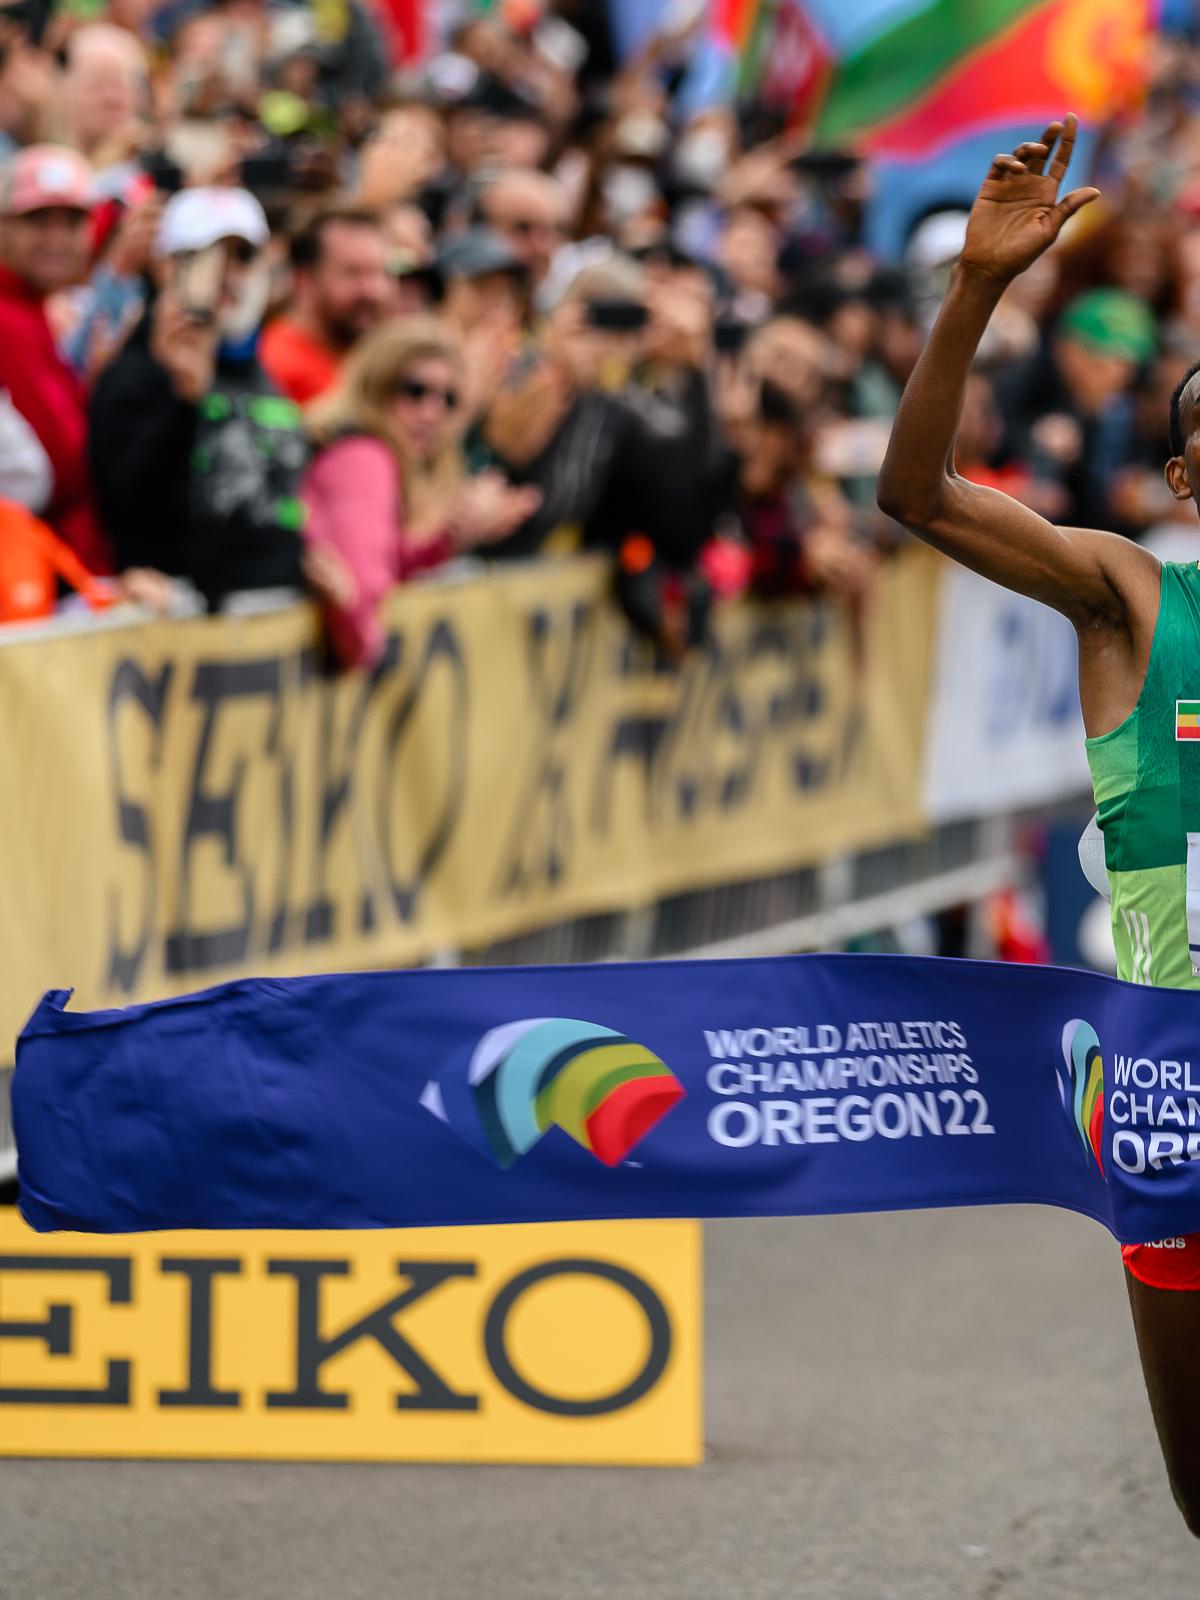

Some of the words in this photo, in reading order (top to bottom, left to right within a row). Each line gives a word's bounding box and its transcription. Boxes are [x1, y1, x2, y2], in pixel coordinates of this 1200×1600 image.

[106, 618, 470, 992] SEIKO
[703, 1024, 842, 1058] WORLD
[846, 1021, 967, 1051] ATHLETICS
[706, 1053, 979, 1095] CHAMPIONSHIPS
[707, 1089, 995, 1147] OREGON22
